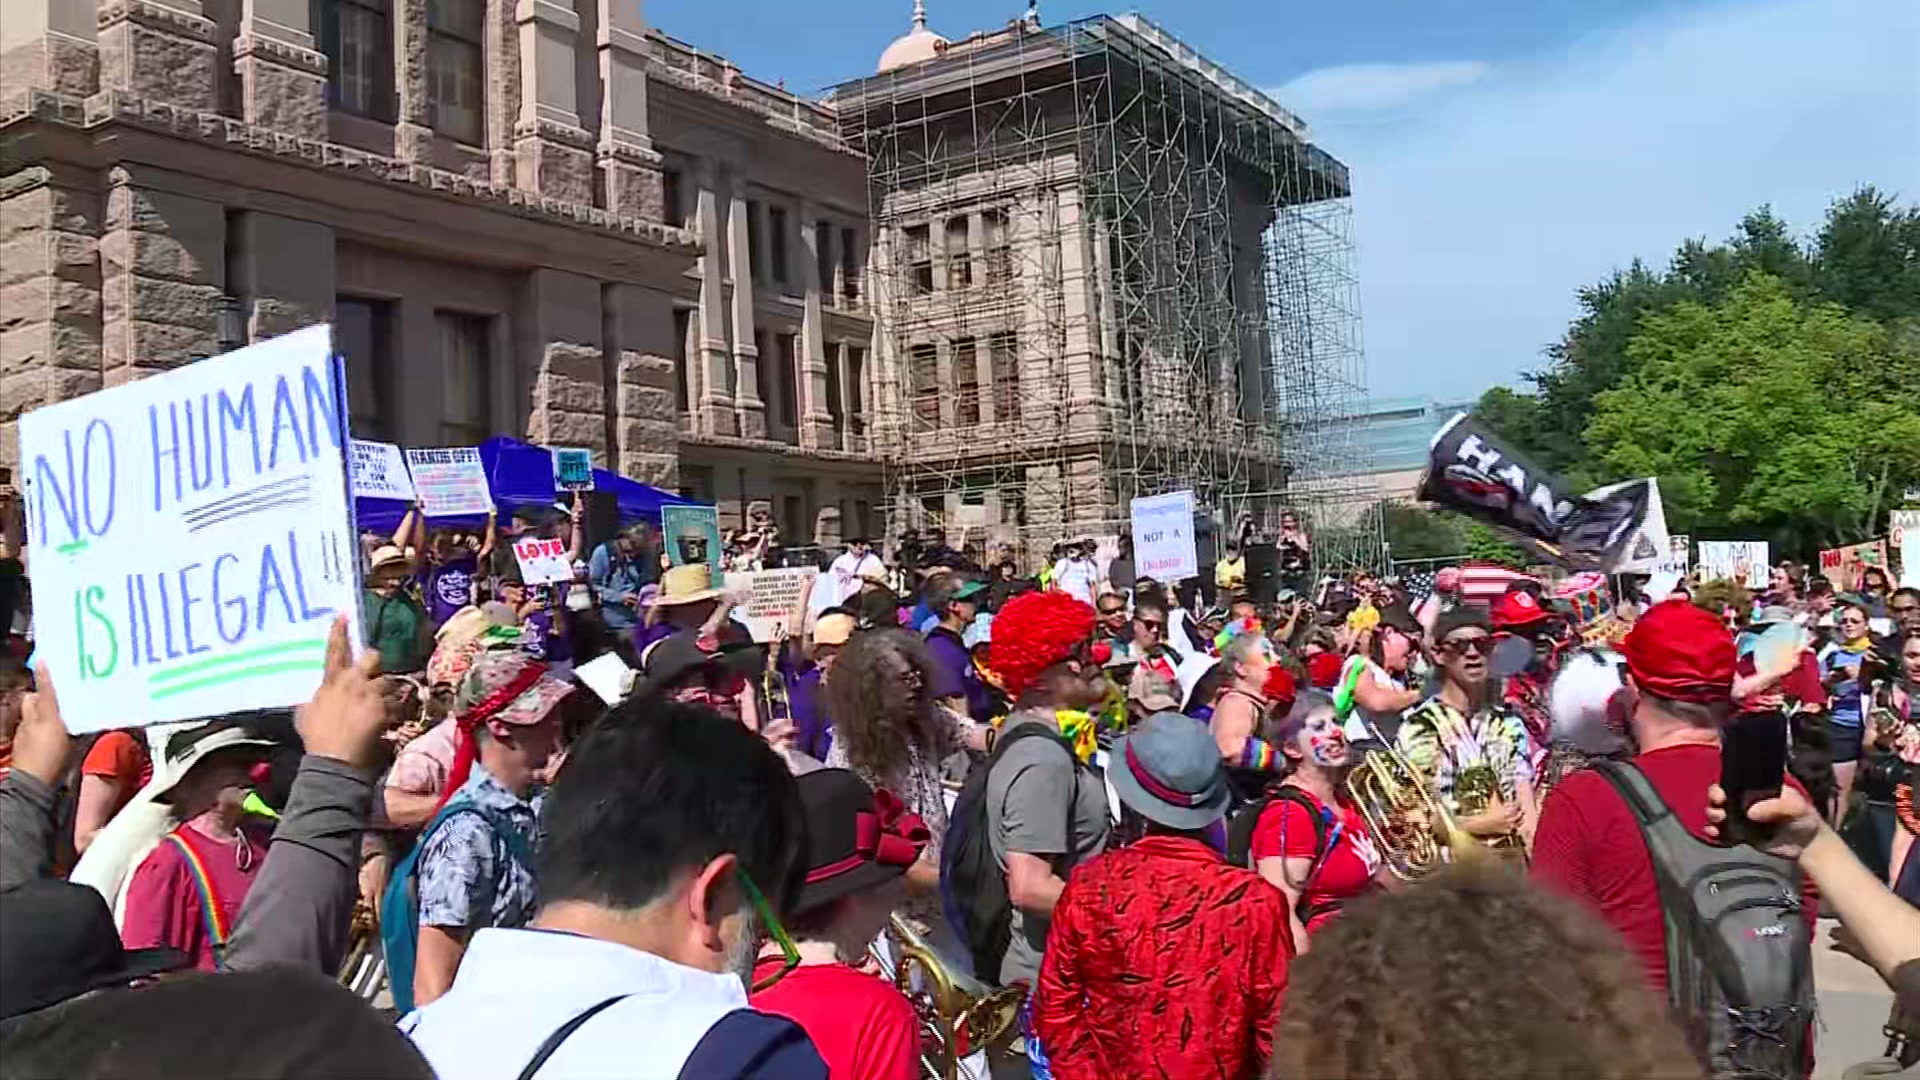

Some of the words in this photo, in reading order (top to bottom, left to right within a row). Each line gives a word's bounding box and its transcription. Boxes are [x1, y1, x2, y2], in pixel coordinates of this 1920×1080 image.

[149, 350, 342, 512] HUMAN
[411, 451, 451, 465] HANDS
[1143, 531, 1164, 543] NOT
[1173, 528, 1181, 541] A
[517, 540, 564, 561] LOVE
[74, 586, 119, 681] IS
